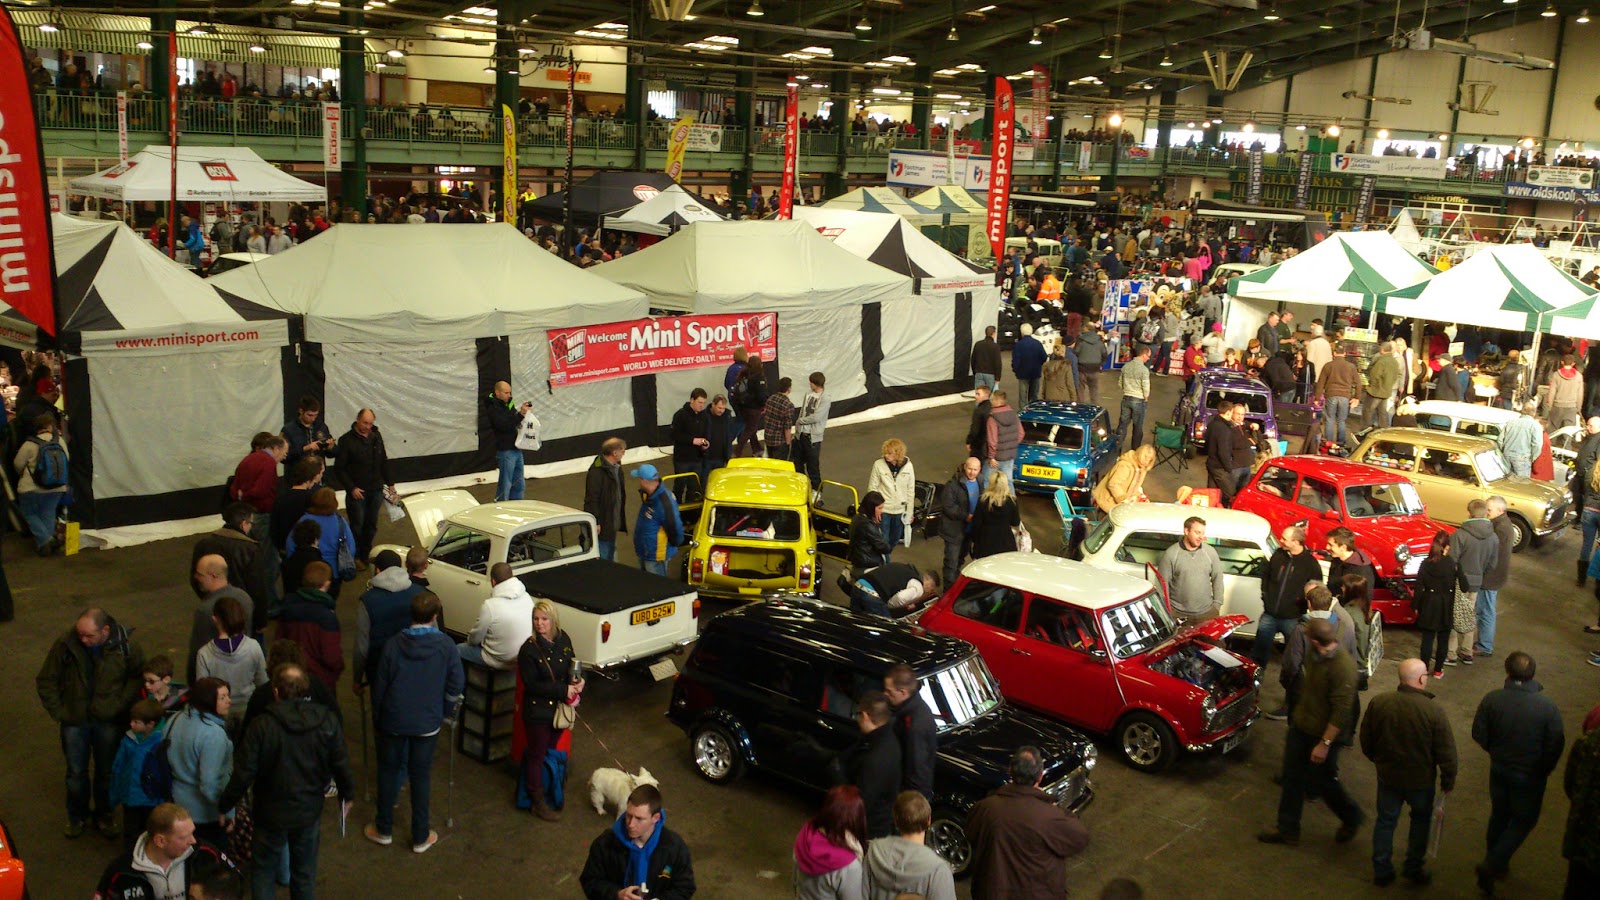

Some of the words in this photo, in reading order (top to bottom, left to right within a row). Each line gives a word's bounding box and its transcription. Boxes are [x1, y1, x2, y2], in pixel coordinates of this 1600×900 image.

[989, 119, 1009, 243] minisport
[1413, 193, 1445, 203] Cashiers
[1446, 195, 1469, 204] Office
[932, 280, 985, 290] www.minisport.com
[115, 330, 259, 348] www.minisport.com
[587, 332, 628, 344] Welcome
[630, 319, 681, 351] Mini
[687, 318, 746, 351] Sport
[618, 341, 628, 351] to
[622, 360, 648, 372] WORLD
[570, 366, 620, 379] www.minisport.com
[1026, 467, 1042, 475] M613
[1042, 468, 1057, 477] XKF
[652, 604, 672, 618] 625W
